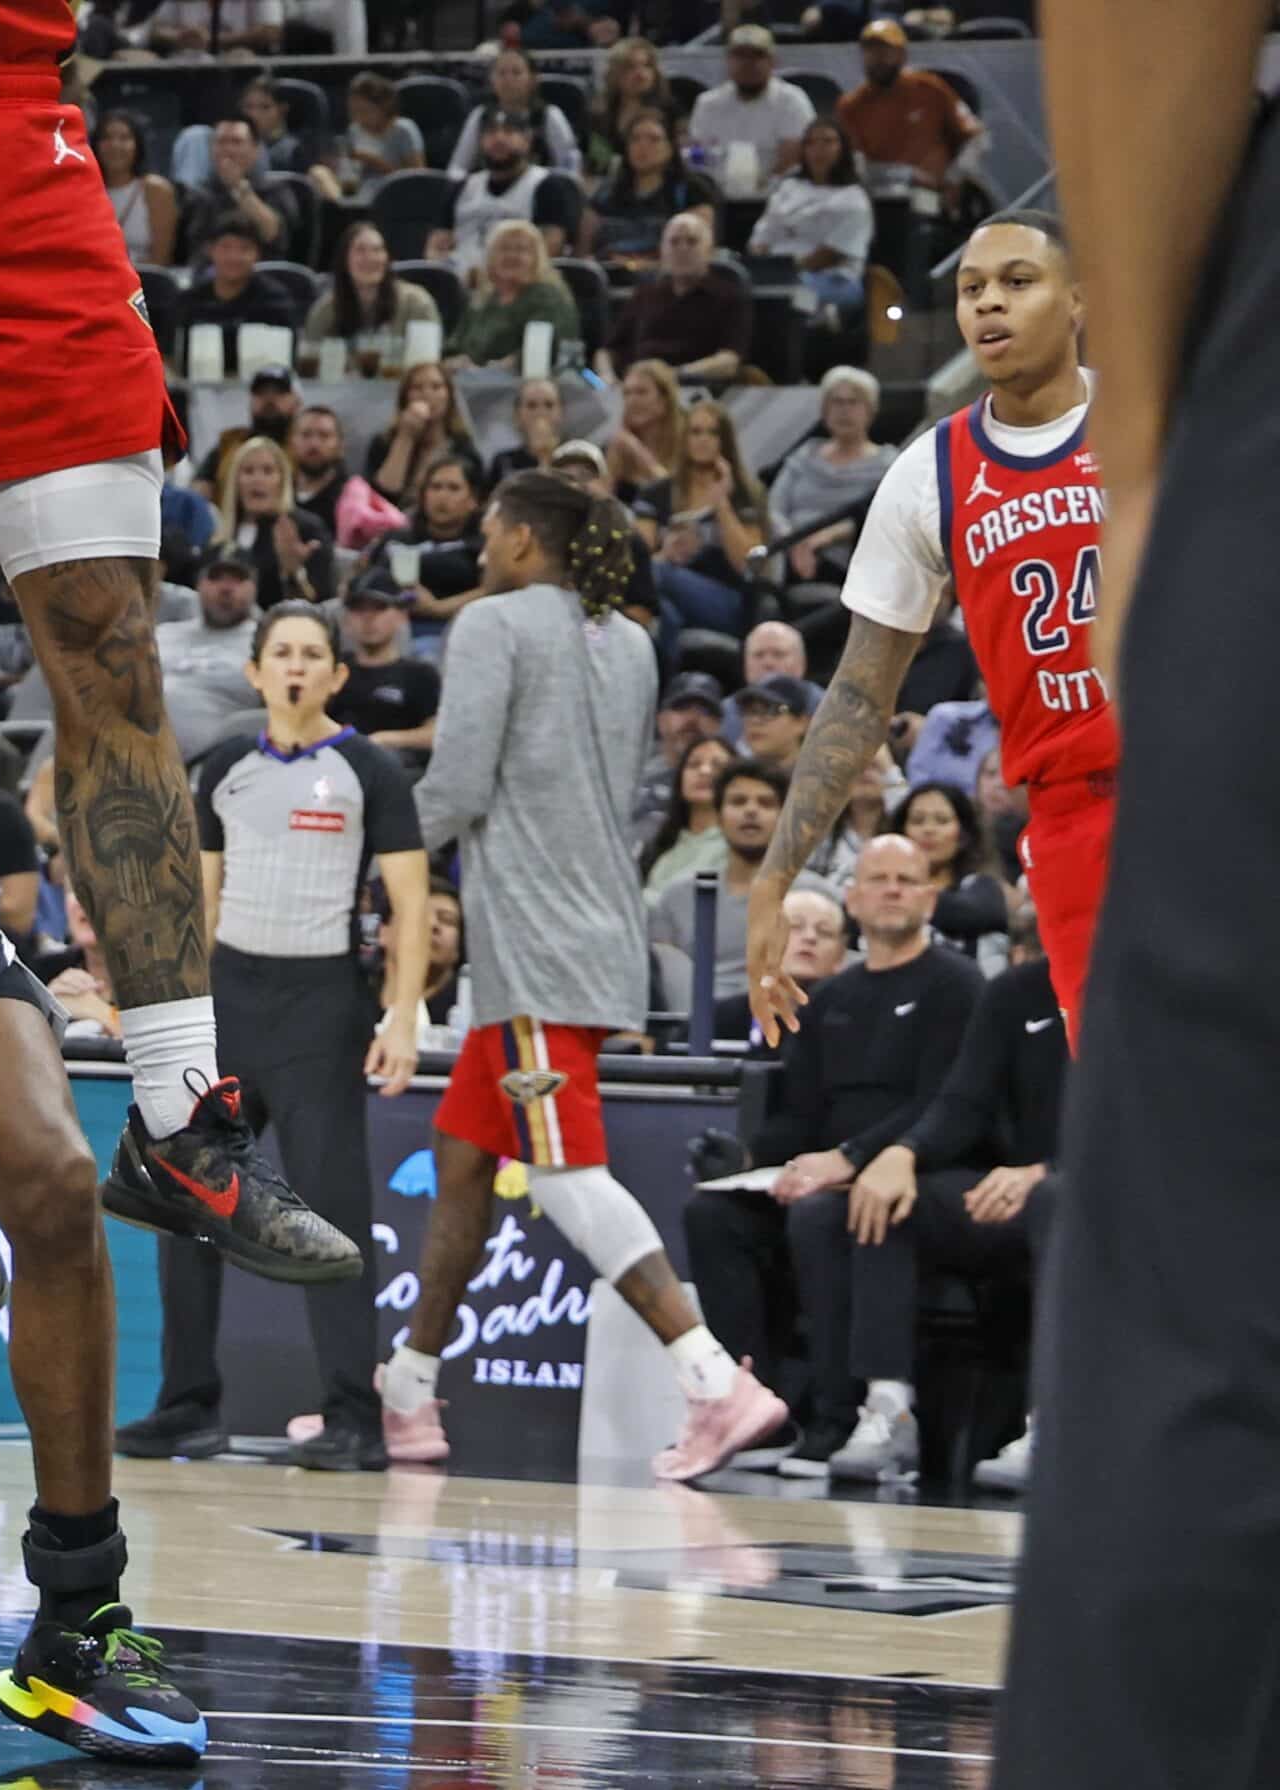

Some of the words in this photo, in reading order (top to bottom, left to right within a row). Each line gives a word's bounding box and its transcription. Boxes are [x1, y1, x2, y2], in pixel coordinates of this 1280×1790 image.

[965, 485, 1107, 568] CRESCEN
[1011, 544, 1104, 656] 24
[472, 1357, 583, 1388] ISLAN
